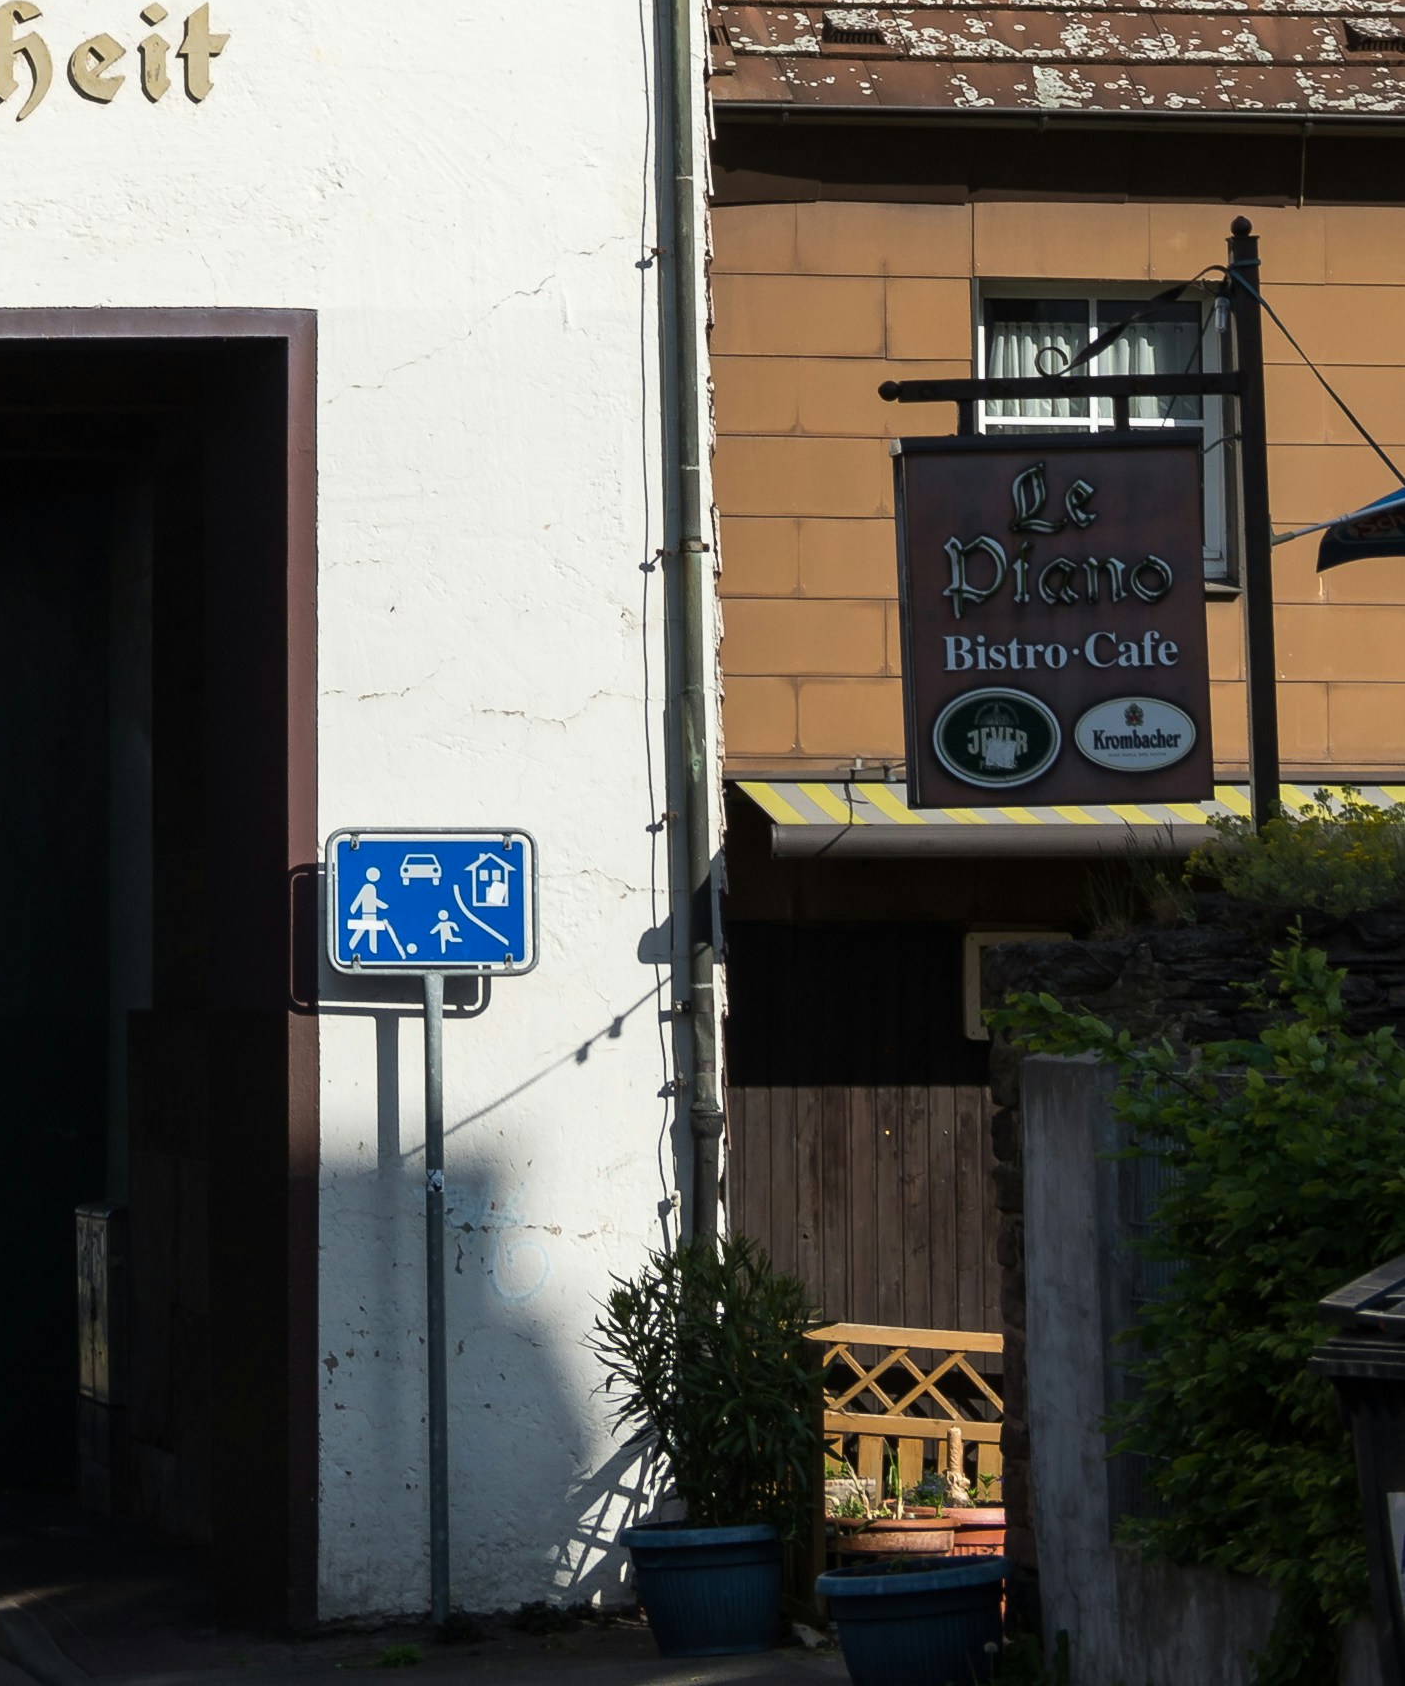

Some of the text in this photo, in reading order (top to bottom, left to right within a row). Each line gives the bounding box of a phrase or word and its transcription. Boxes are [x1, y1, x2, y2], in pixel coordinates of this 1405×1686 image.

[1010, 462, 1098, 534] Le
[943, 534, 1173, 619] Piano
[1092, 728, 1182, 751] Krombacher
